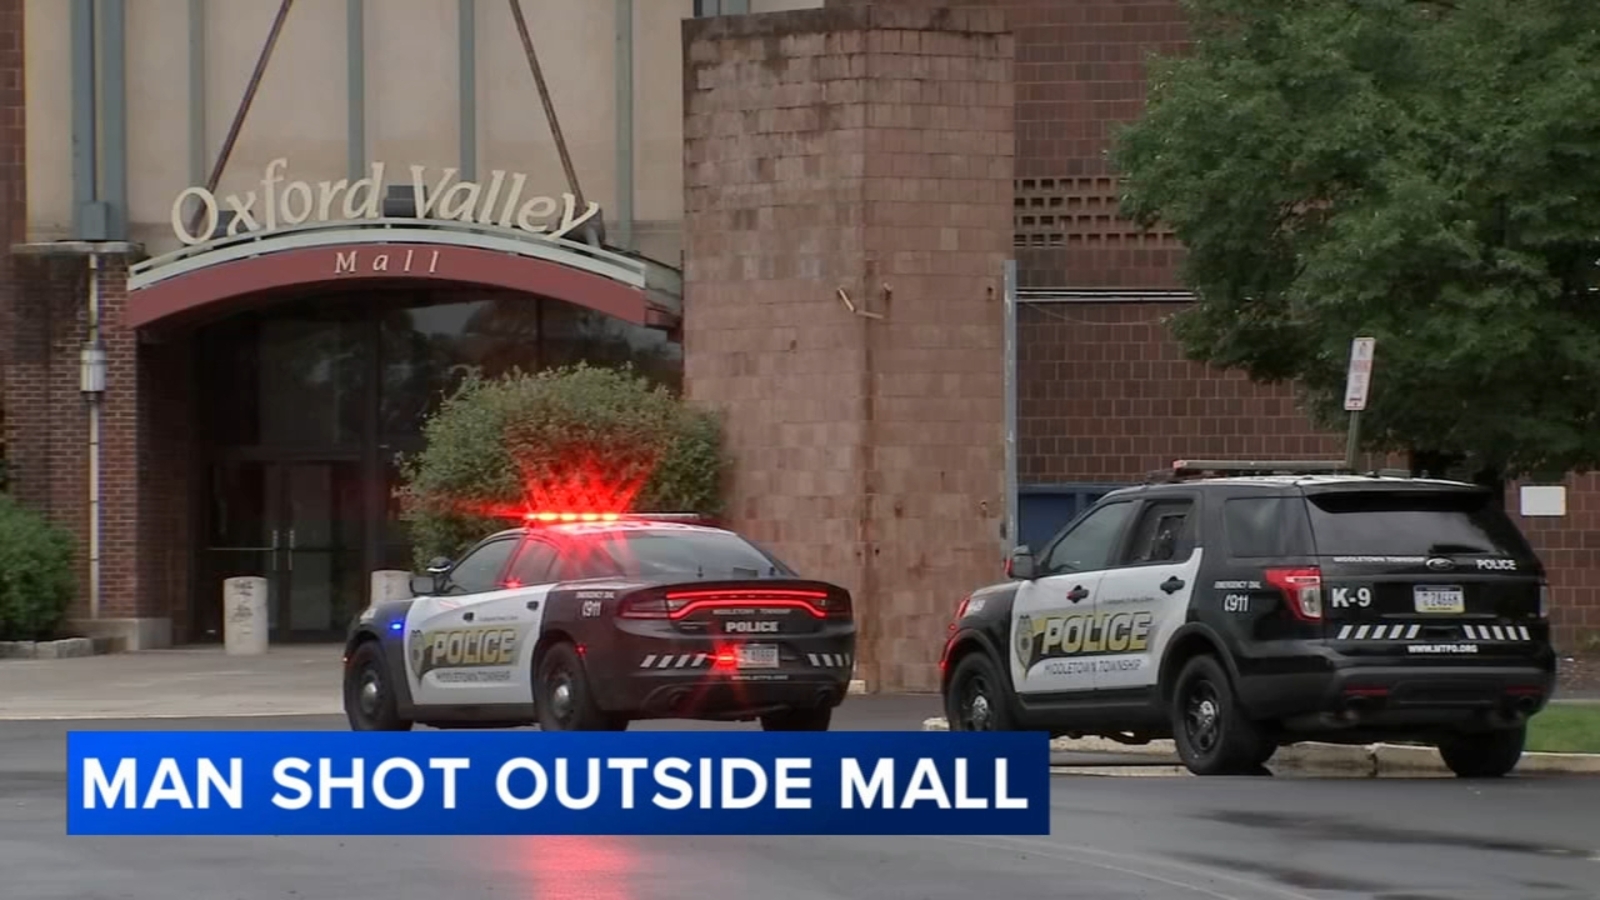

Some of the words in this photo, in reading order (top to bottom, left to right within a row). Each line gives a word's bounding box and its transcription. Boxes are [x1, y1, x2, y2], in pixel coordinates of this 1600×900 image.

[170, 158, 386, 246] Oxford
[409, 165, 601, 241] Valley
[334, 249, 440, 274] Mall
[1475, 559, 1517, 571] POLICE
[1332, 587, 1371, 608] K-9
[725, 621, 780, 632] POLICE
[1040, 610, 1153, 655] POLICE
[430, 628, 516, 666] POLICE
